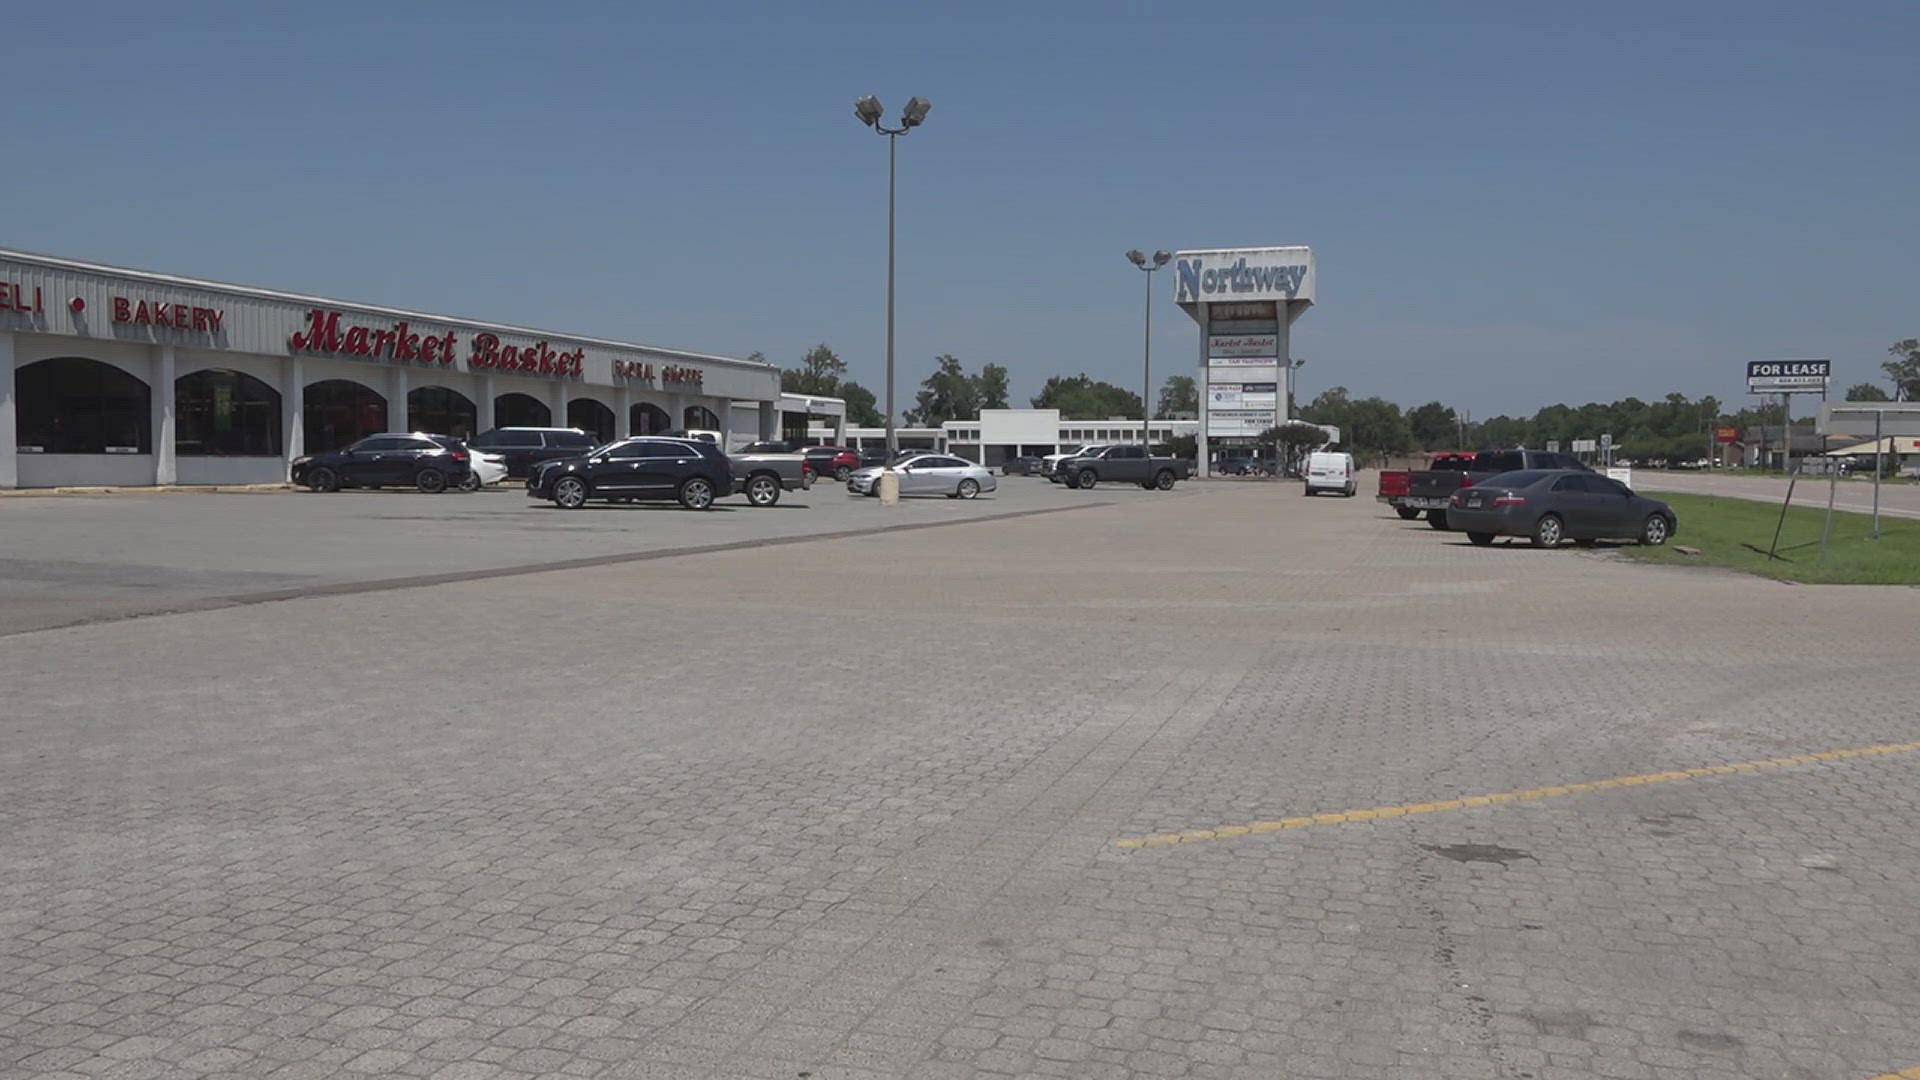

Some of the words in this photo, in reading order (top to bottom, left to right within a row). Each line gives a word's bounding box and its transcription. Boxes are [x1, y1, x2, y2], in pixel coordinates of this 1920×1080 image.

[1177, 257, 1307, 301] Northway
[112, 297, 225, 333] BAKERY
[291, 310, 458, 363] Market
[472, 332, 586, 377] Basket
[614, 360, 656, 380] FLORAL
[1752, 364, 1781, 375] FOR
[1783, 364, 1827, 375] LEASE
